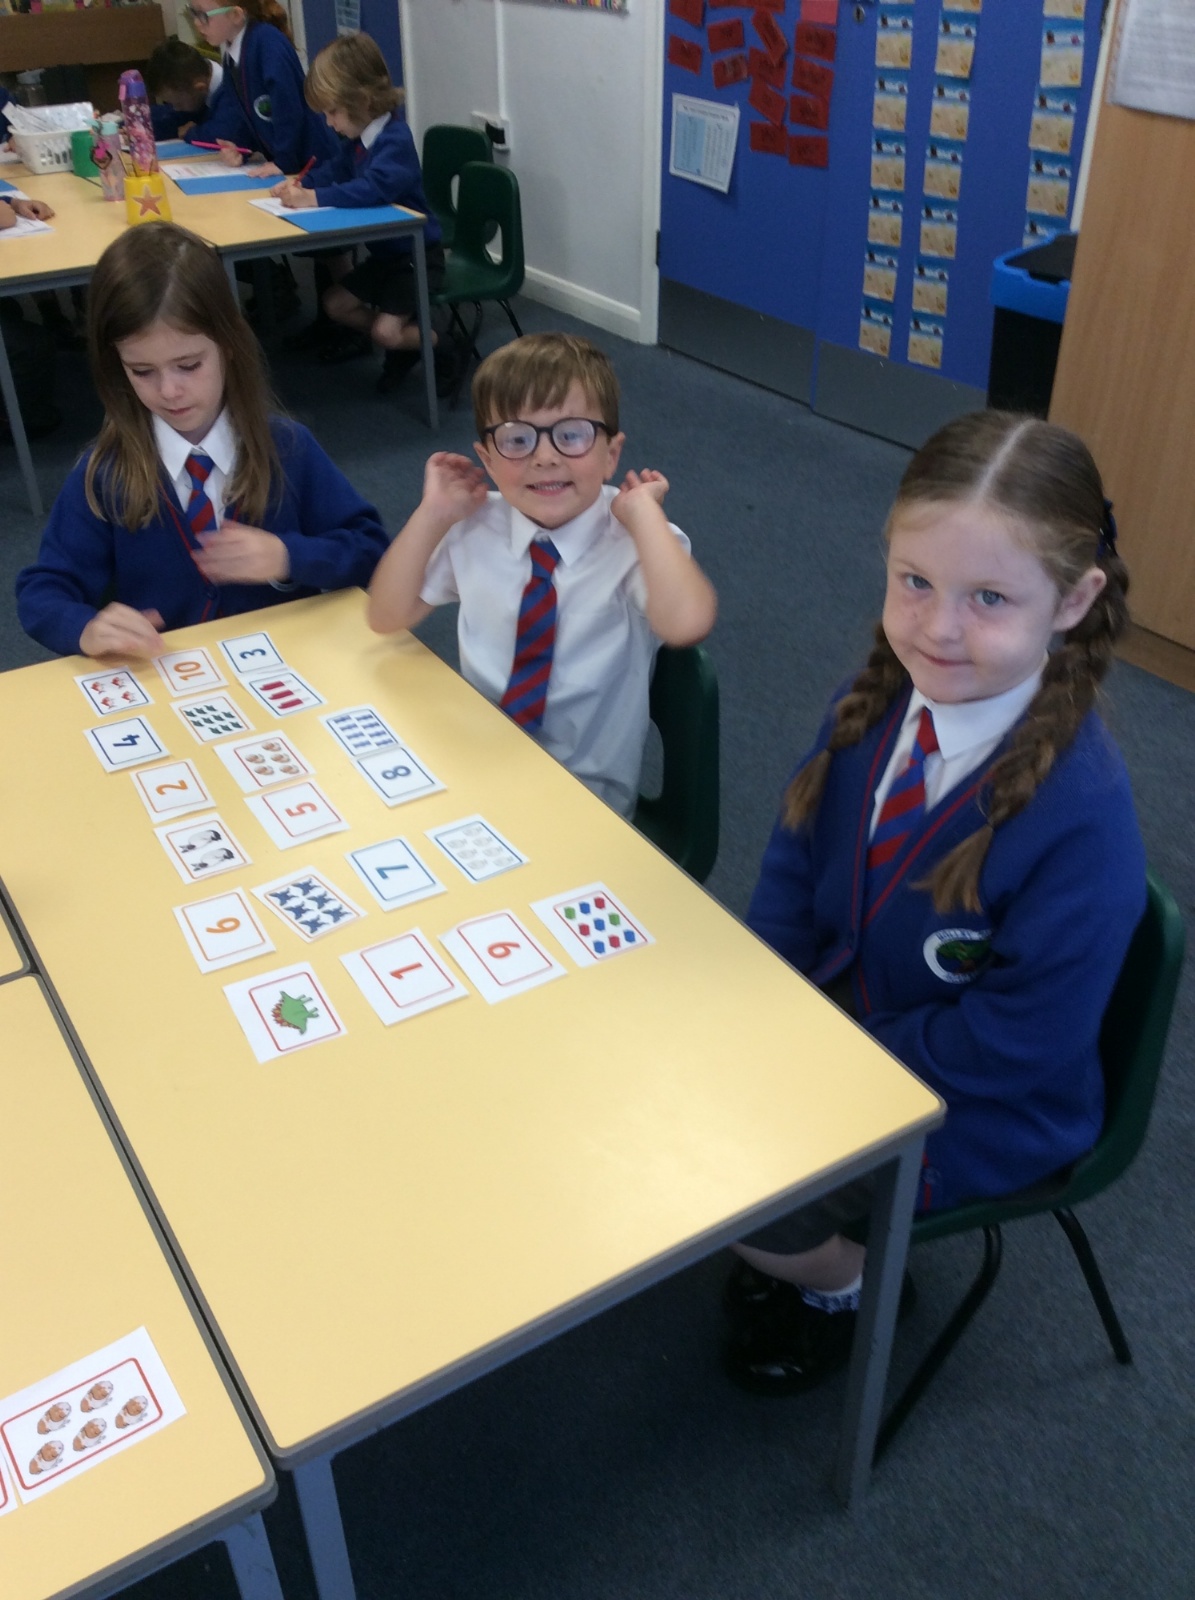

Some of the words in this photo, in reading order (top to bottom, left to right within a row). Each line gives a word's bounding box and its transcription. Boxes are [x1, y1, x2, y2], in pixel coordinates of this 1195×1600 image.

[239, 648, 267, 661] 3
[173, 661, 206, 681] 10
[112, 734, 141, 748] 4
[381, 765, 412, 781] 8
[155, 779, 189, 796] 2
[284, 802, 318, 818] 5
[375, 864, 410, 880] 7
[389, 962, 423, 980] 1
